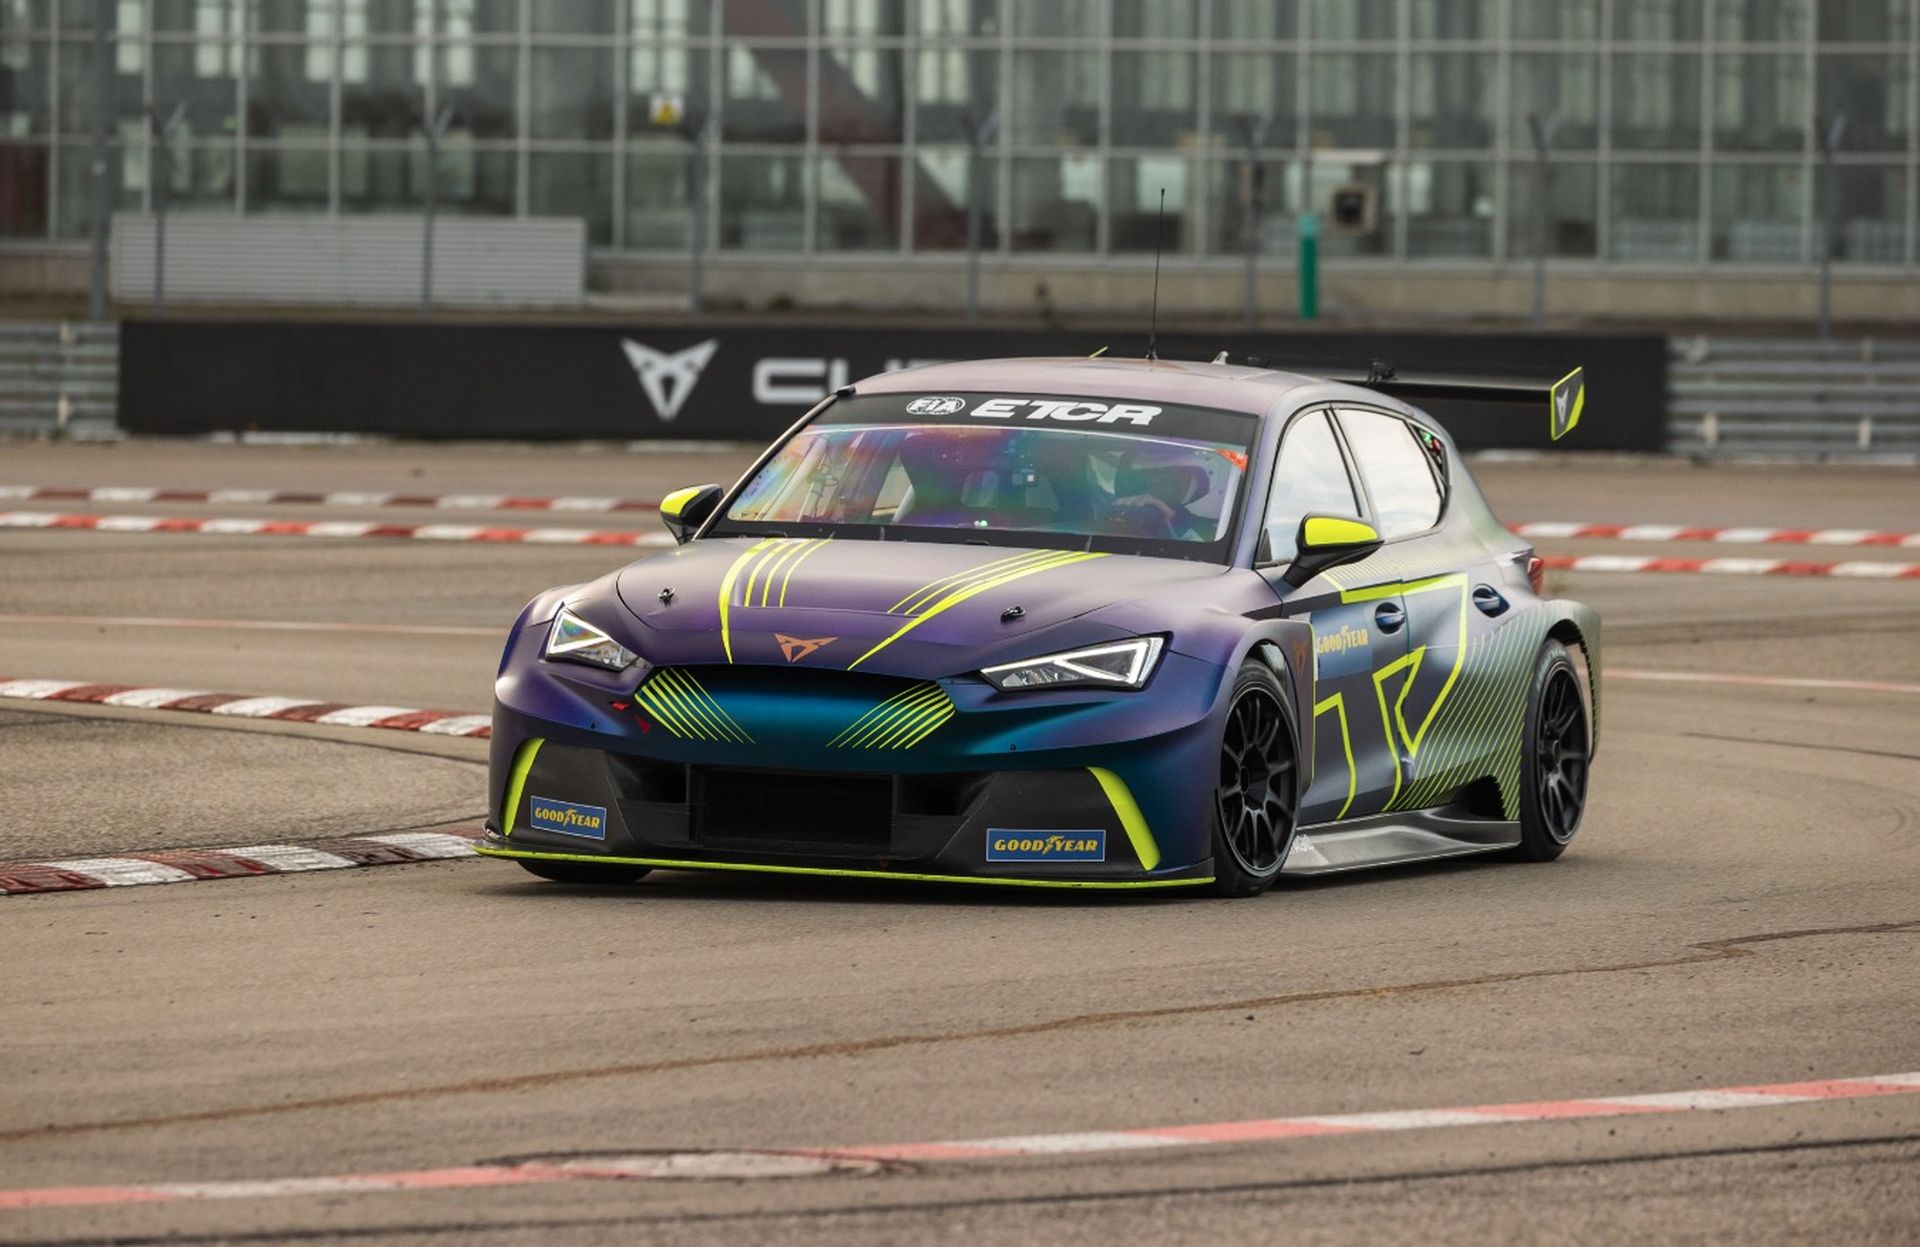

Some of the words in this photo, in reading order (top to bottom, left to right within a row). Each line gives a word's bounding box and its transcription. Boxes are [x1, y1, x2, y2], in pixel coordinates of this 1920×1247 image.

[908, 398, 961, 412] FIA
[970, 399, 1163, 426] ETCR
[534, 807, 601, 829] GOODYEAR
[994, 835, 1098, 855] GOODYEAR
